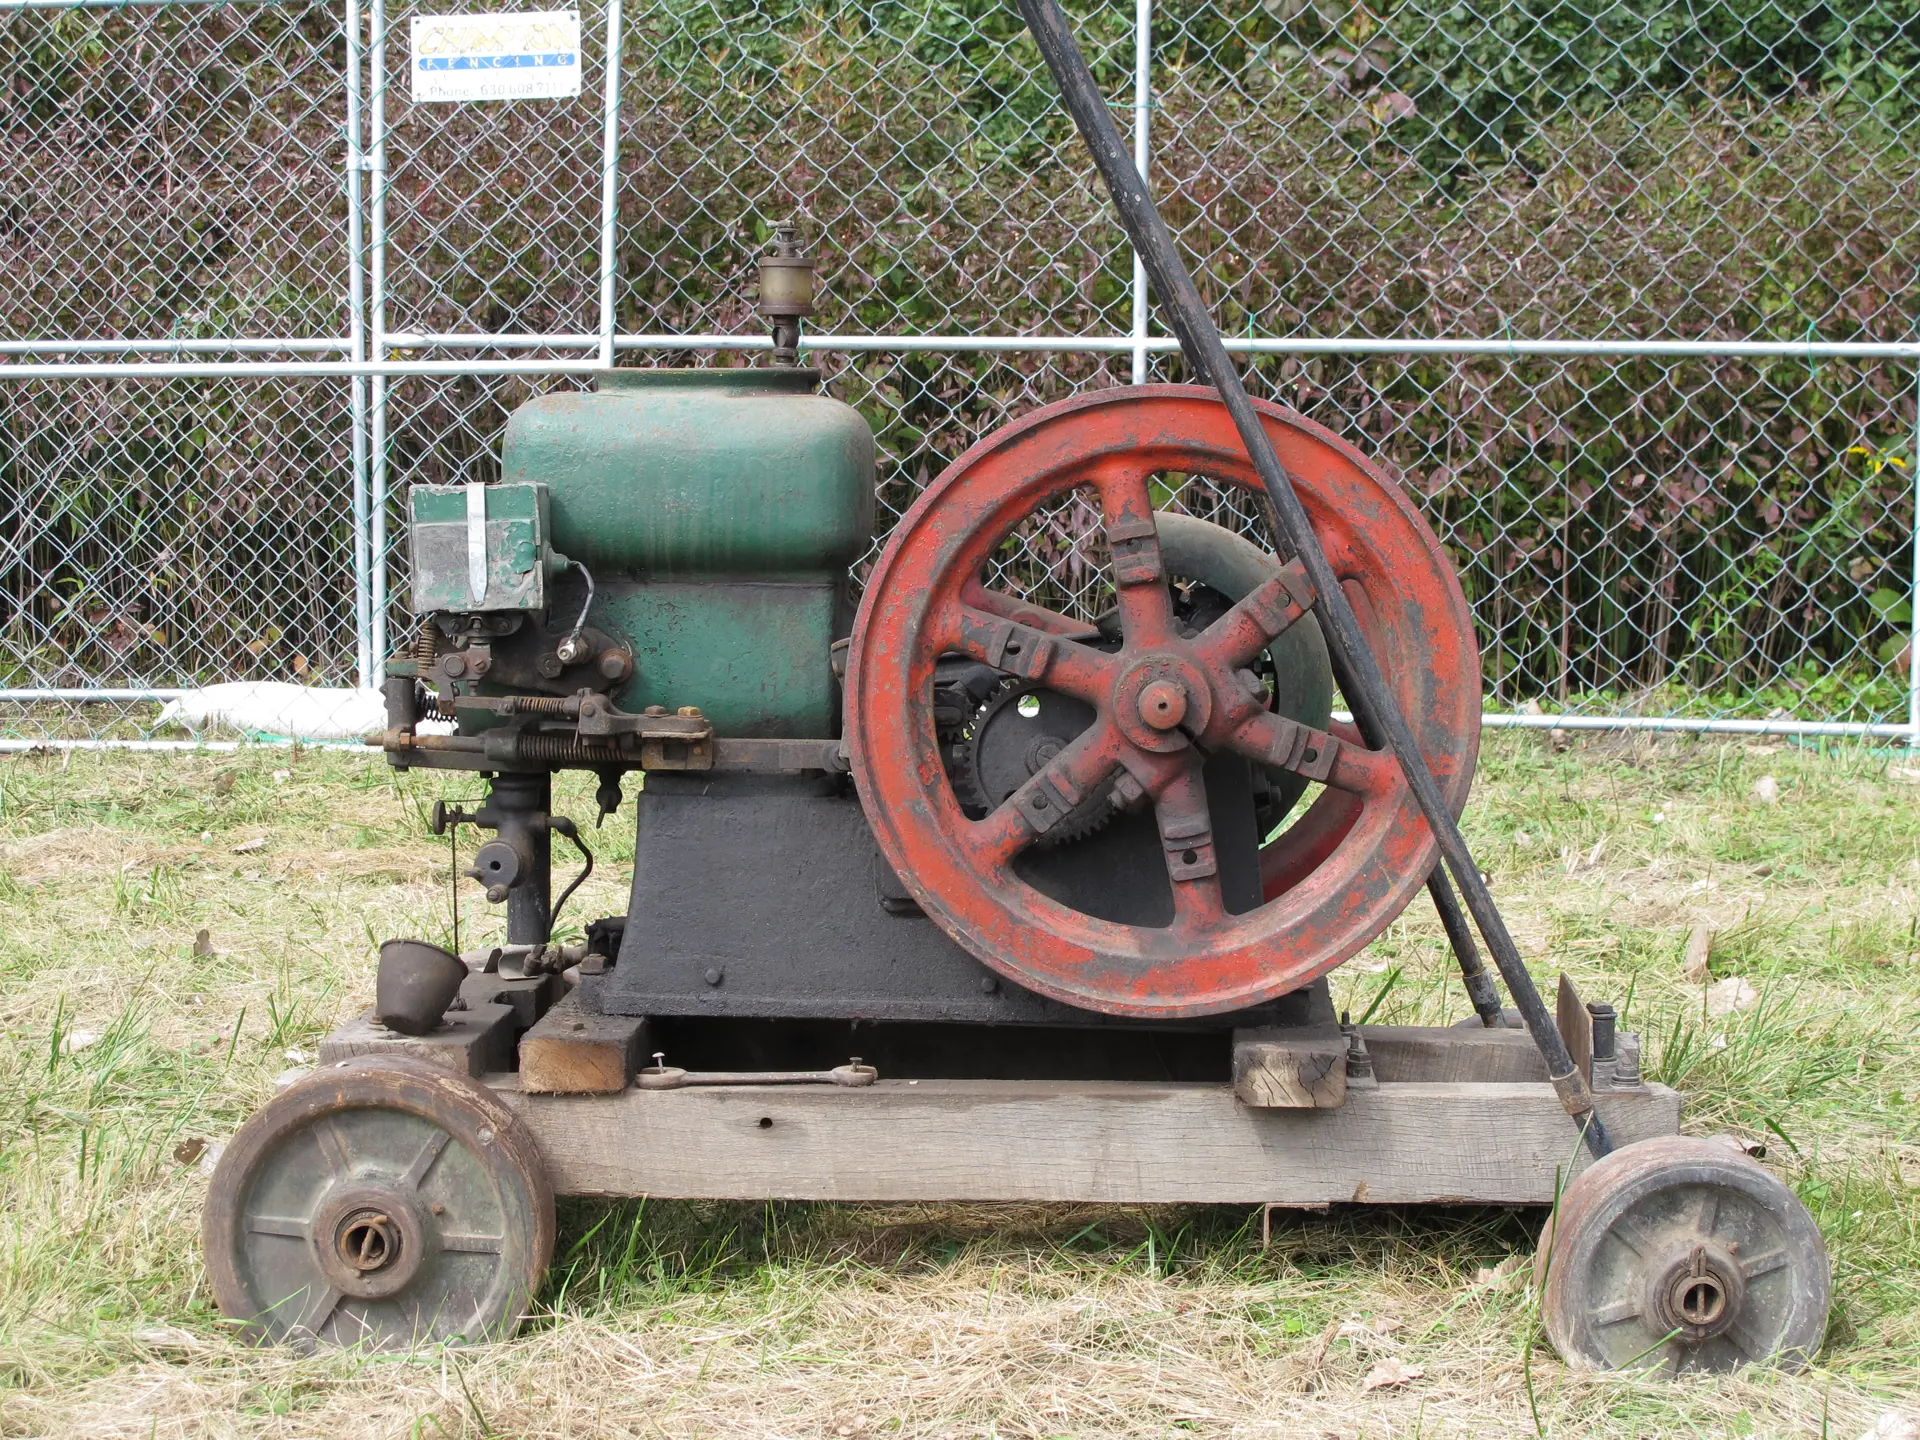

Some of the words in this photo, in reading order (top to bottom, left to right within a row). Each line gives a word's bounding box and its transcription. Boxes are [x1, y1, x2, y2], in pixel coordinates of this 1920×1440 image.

[418, 22, 576, 55] CHAMPON
[427, 53, 567, 70] FENCING
[480, 83, 506, 96] 630
